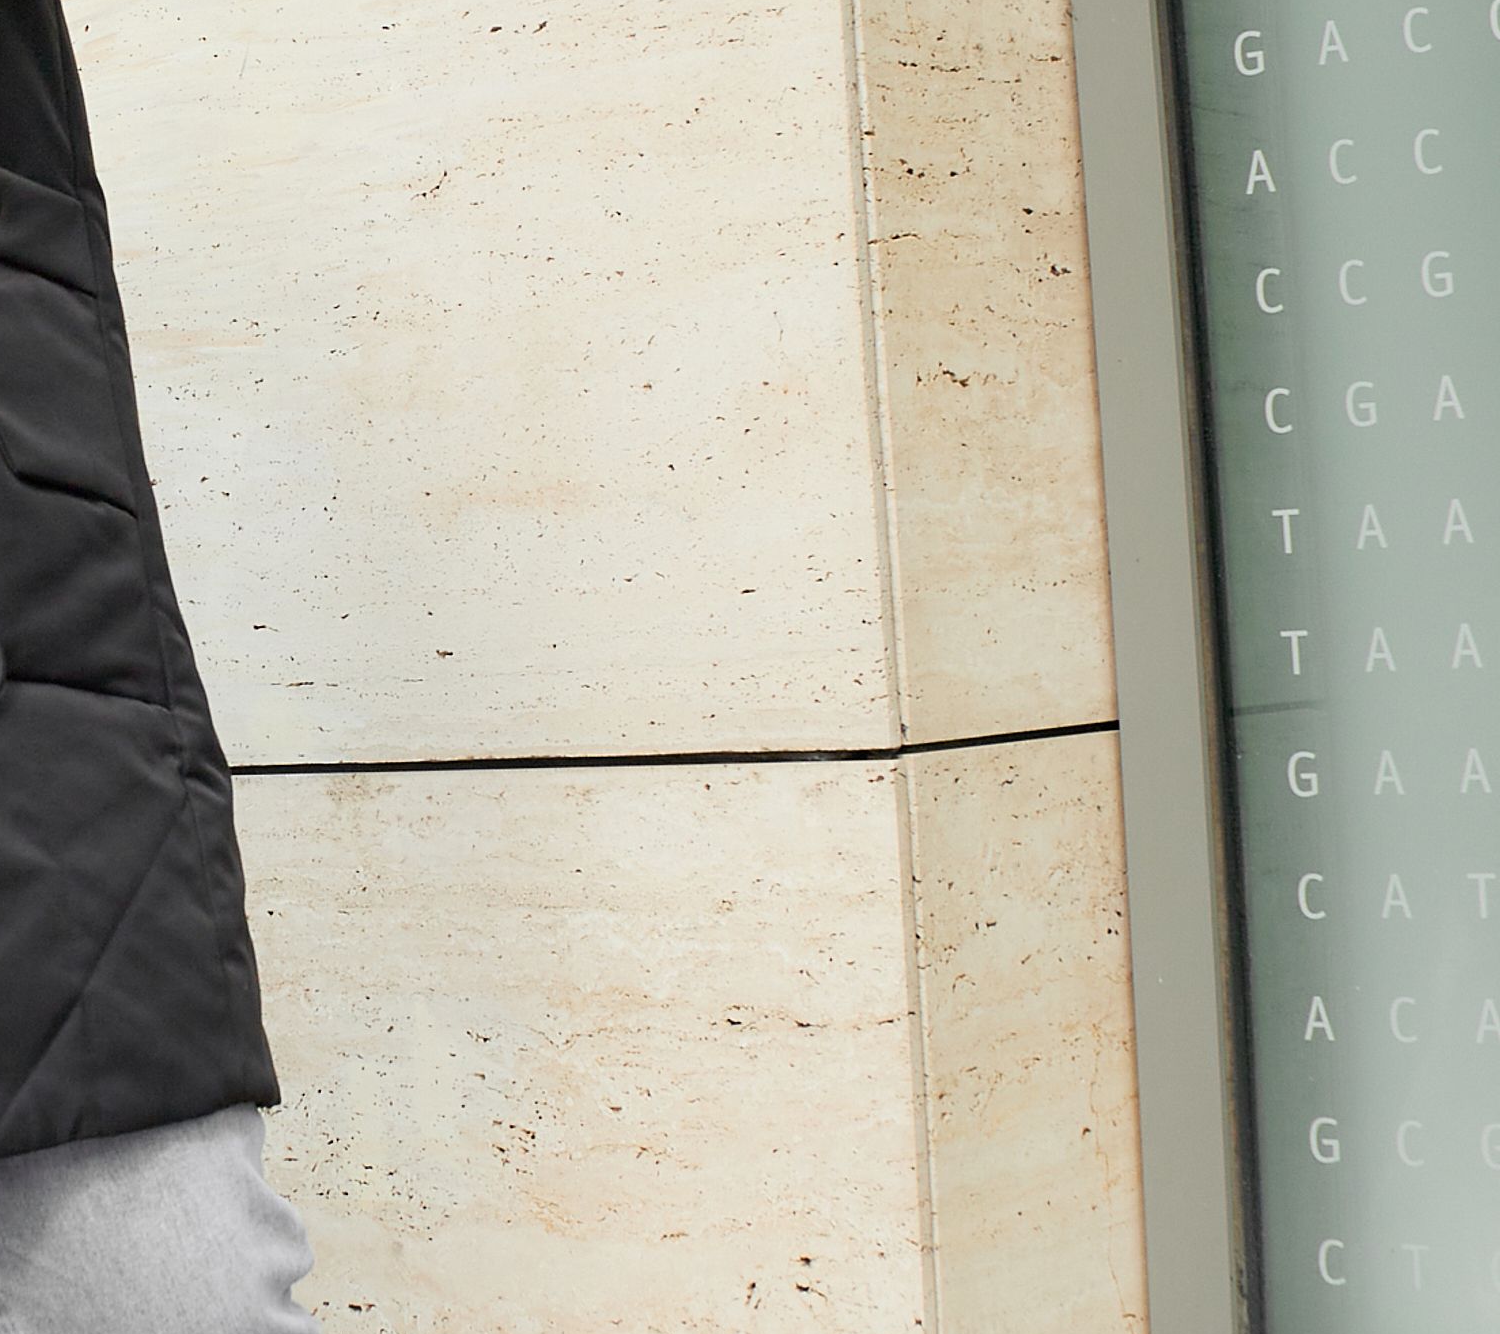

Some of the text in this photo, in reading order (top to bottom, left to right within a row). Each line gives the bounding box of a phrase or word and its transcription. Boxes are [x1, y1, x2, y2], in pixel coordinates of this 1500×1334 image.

[1234, 7, 1432, 76] G A C
[1246, 128, 1443, 195] A C C
[1255, 250, 1454, 314] C C G
[1264, 375, 1465, 434] C G A
[1271, 498, 1474, 554] T A A
[1280, 623, 1483, 675] T A A
[1287, 748, 1492, 798] G A A
[1297, 872, 1497, 920] C A T
[1303, 995, 1336, 1042] A
[1389, 996, 1418, 1043] C
[1309, 1117, 1341, 1164] G
[1396, 1120, 1425, 1167] C
[1318, 1238, 1429, 1291] C T
